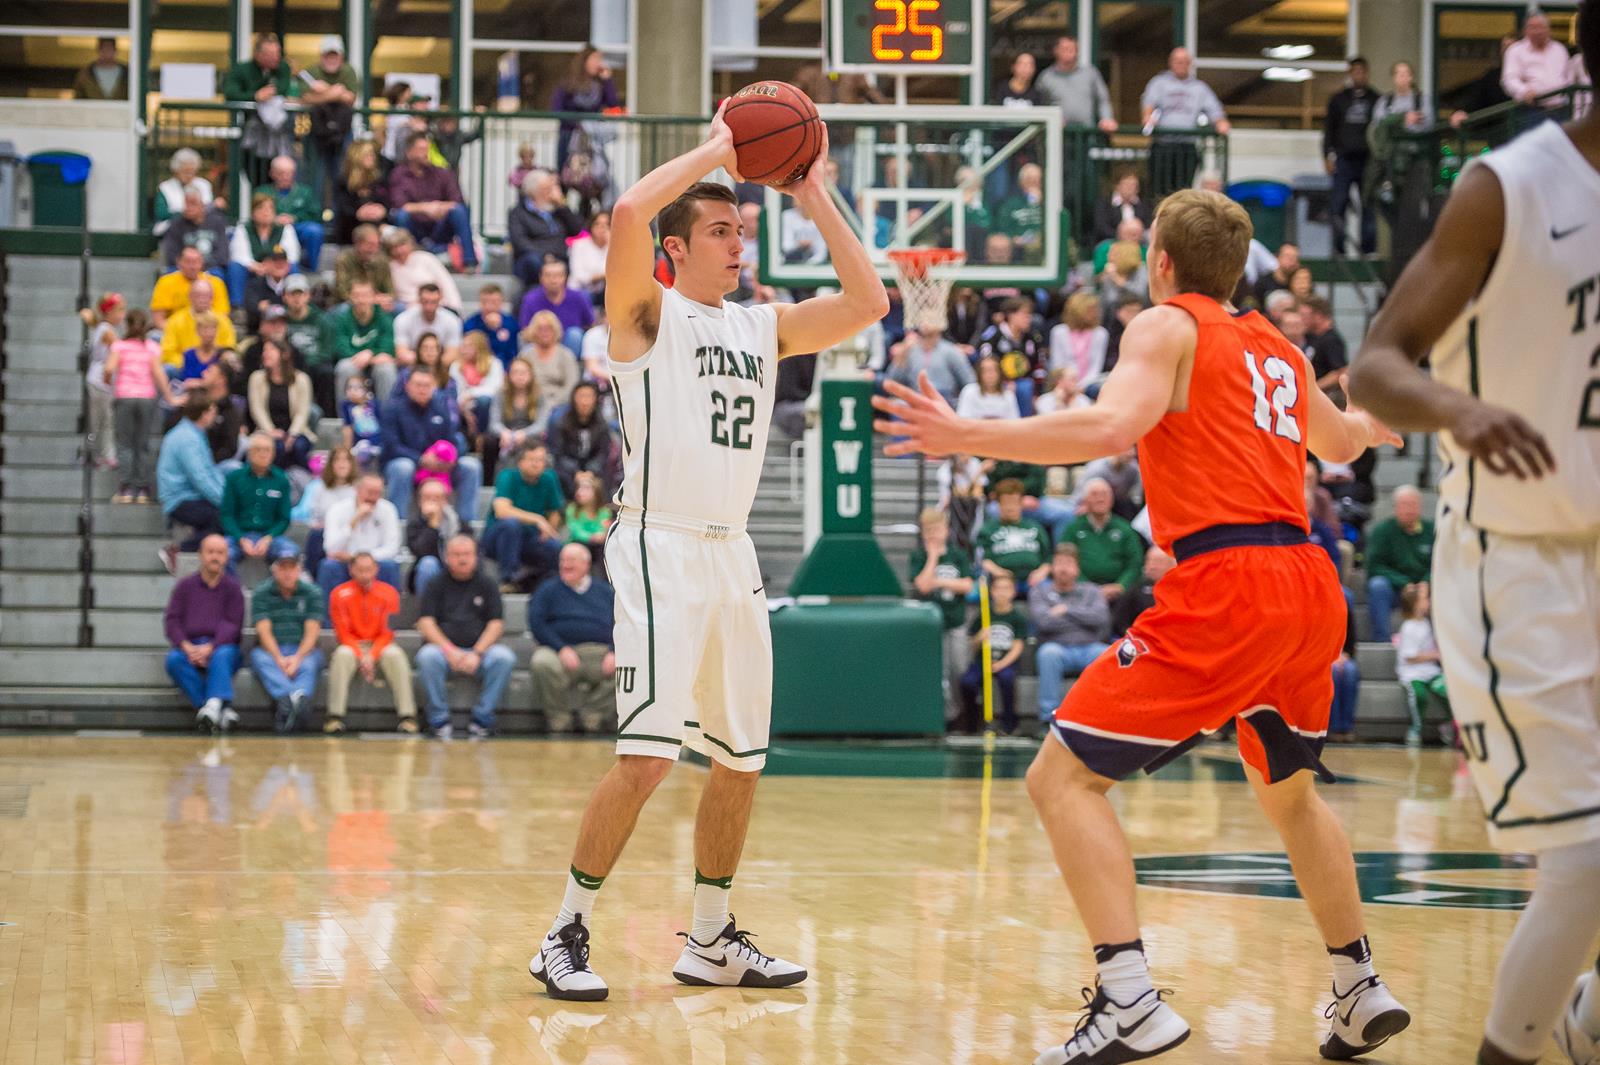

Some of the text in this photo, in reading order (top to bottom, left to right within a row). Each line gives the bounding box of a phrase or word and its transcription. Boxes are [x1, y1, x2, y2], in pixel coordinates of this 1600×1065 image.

[872, 0, 943, 60] 25
[695, 345, 764, 389] TITANS
[1244, 349, 1301, 445] 12
[711, 389, 755, 450] 22
[832, 396, 863, 518] IWU
